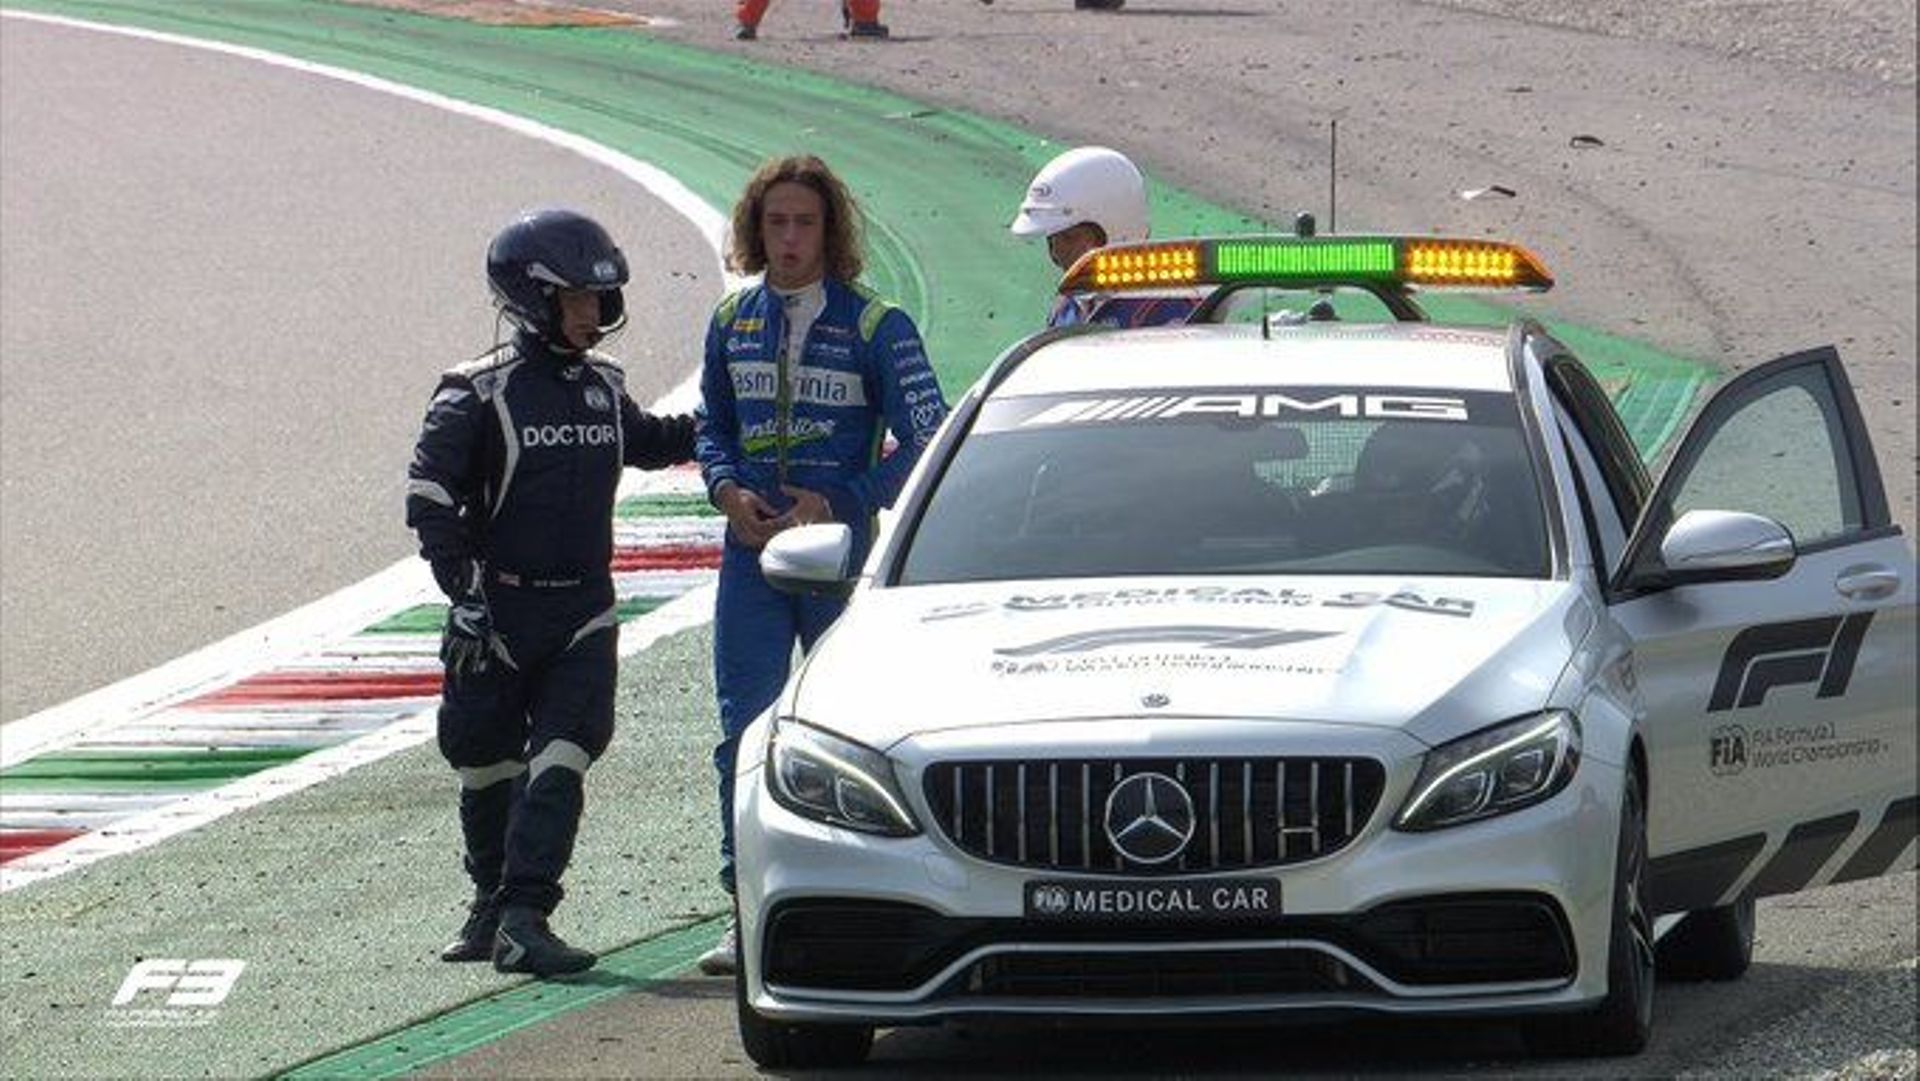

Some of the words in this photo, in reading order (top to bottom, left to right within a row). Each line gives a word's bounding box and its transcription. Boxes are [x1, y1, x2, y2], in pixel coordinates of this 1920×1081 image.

[1158, 395, 1469, 421] AMG
[523, 424, 616, 447] DOCTOR
[1711, 735, 1747, 768] FIA
[1073, 889, 1201, 912] MEDICAL
[1211, 886, 1270, 910] CAR
